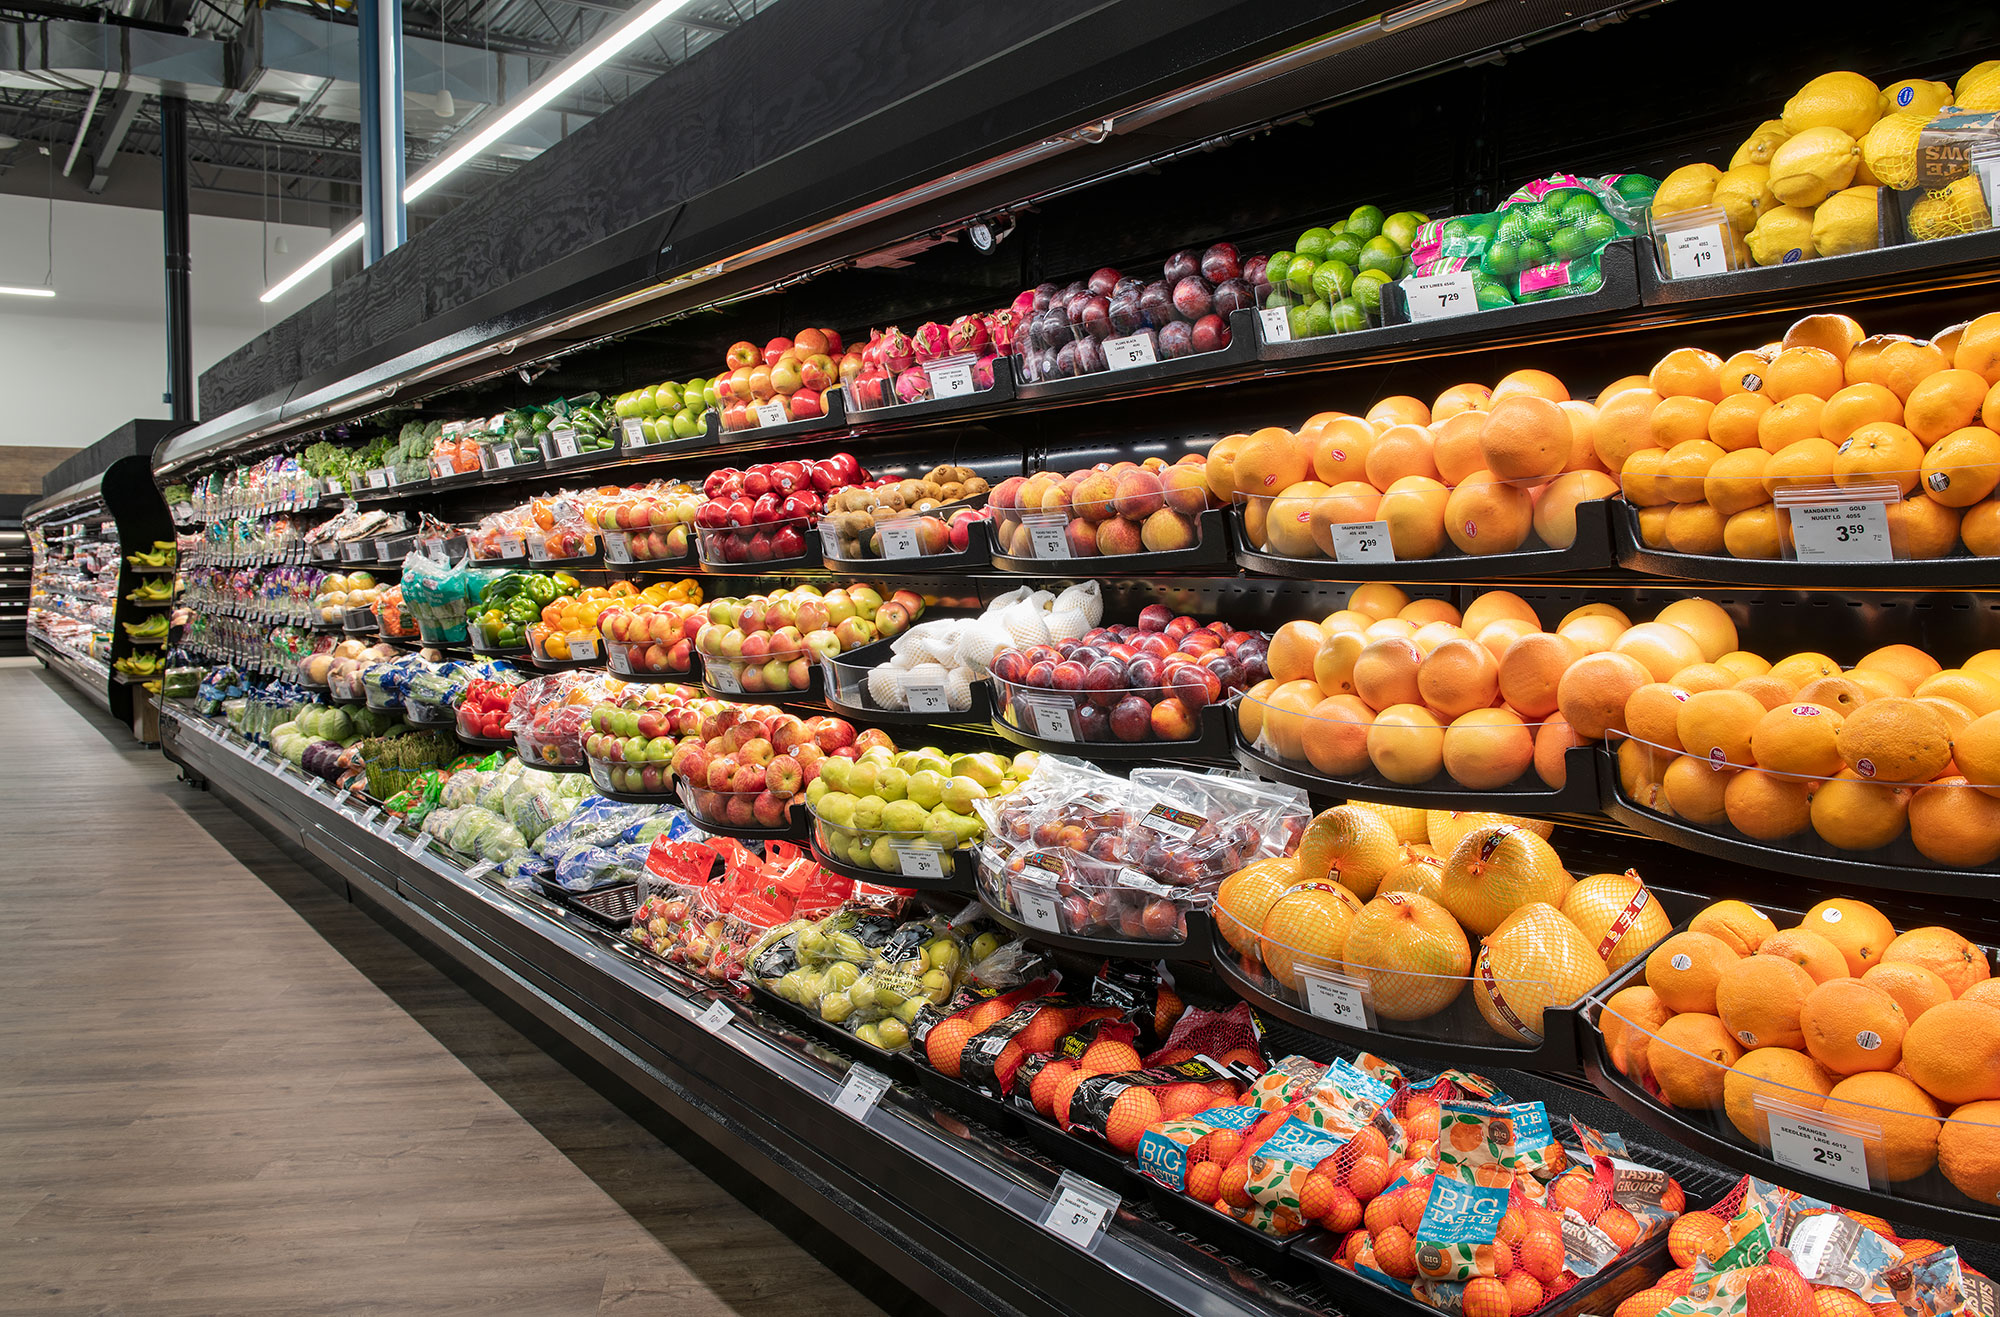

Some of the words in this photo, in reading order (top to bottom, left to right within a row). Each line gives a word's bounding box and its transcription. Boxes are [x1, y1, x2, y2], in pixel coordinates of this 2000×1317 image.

[1280, 1123, 1336, 1152] BIG
[1781, 1126, 1812, 1140] SEEDLESS
[1814, 1137, 1831, 1145] LRGE
[1831, 1141, 1847, 1149] 4012
[1798, 1125, 1827, 1137] ORANGES
[1141, 1140, 1182, 1172] BIG
[1141, 1161, 1181, 1186] TASTE
[1620, 1170, 1665, 1183] TASTE
[1616, 1181, 1662, 1194] GROWS
[1433, 1185, 1500, 1216] BIG
[1430, 1207, 1494, 1225] TASTE
[1561, 1221, 1611, 1254] GROWS
[1424, 1255, 1439, 1264] BIG
